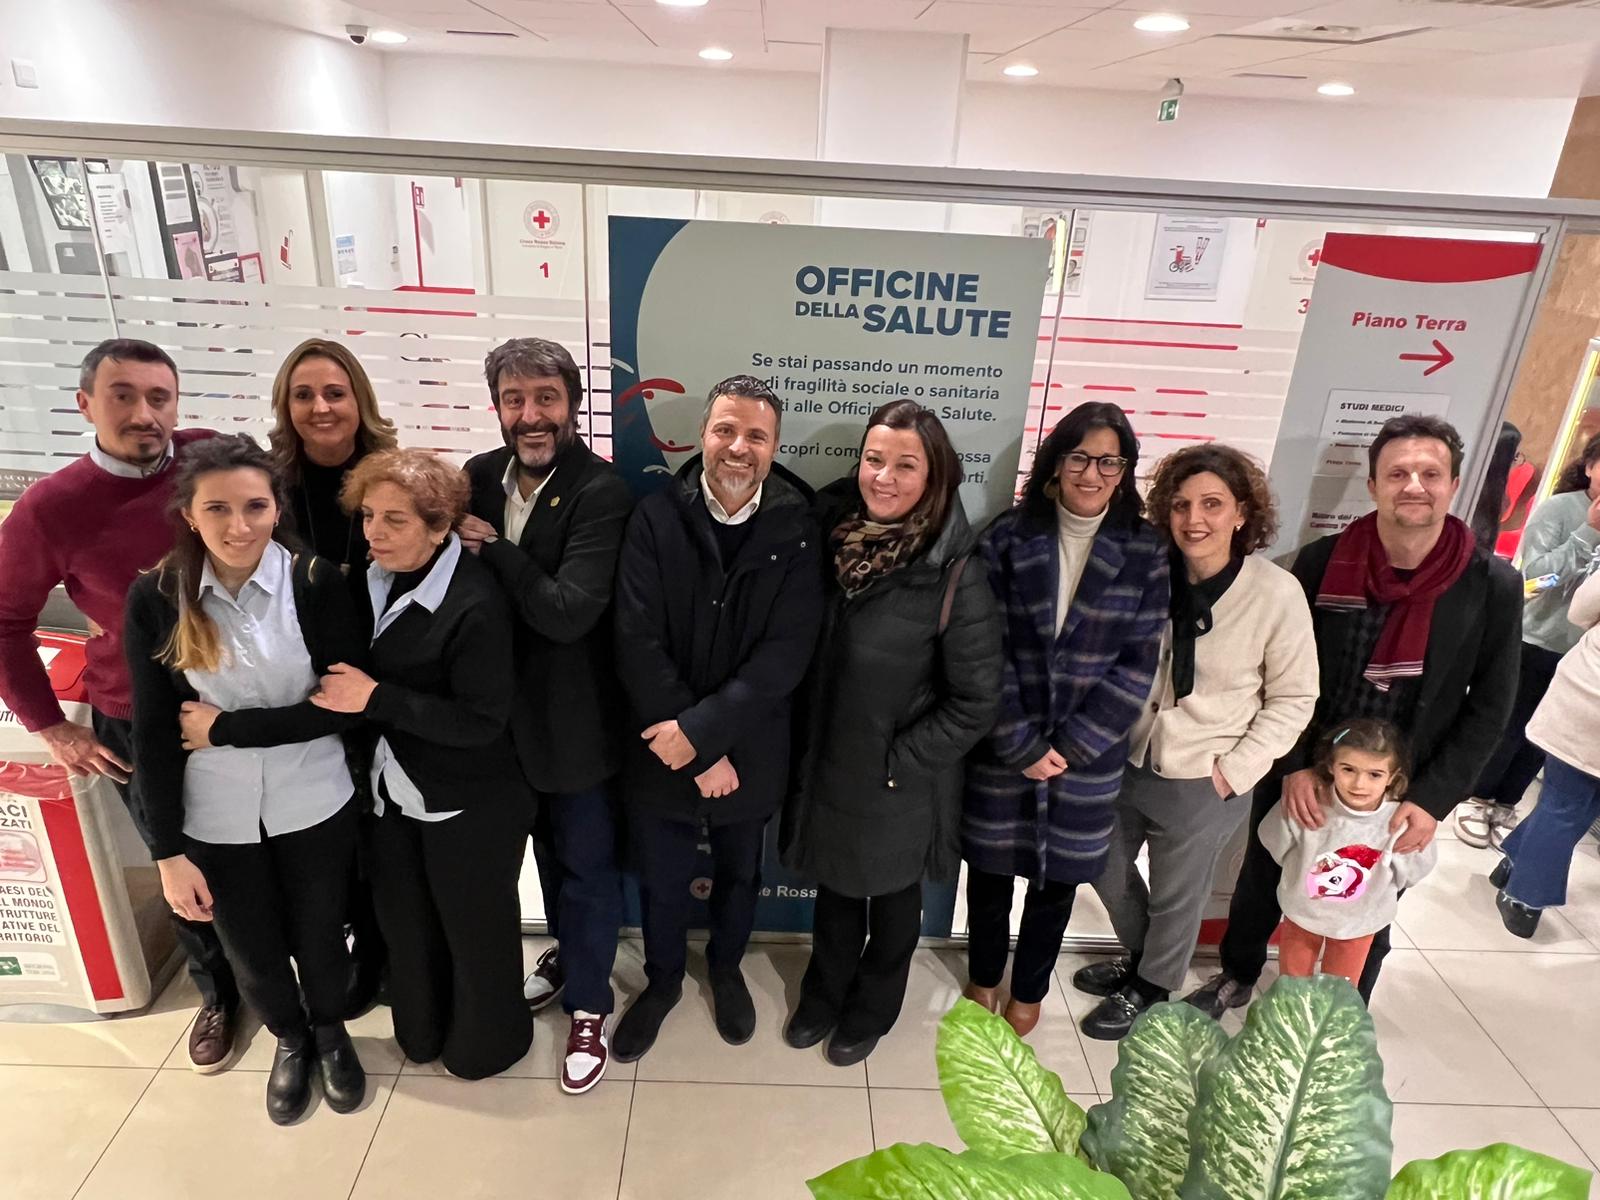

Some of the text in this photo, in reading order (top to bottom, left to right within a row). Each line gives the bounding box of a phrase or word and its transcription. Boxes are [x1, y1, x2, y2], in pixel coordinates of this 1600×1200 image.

[539, 262, 549, 278] 1
[795, 265, 980, 302] OFFICINE
[795, 301, 1012, 339] DELLA SALUTE
[1351, 311, 1468, 332] Piano Terra
[752, 353, 1003, 378] Se stai passando un momento
[765, 376, 1000, 400] di fragilità sociale o sanitaria
[793, 399, 823, 413] alle
[828, 400, 881, 416] Officin
[941, 405, 997, 421] Salute.
[1340, 402, 1405, 413] STUDI MEDICI
[777, 442, 860, 459] copri com
[958, 452, 992, 464] ossa
[777, 885, 818, 898] Ross
[12, 898, 54, 910] MONDO
[39, 922, 61, 933] DEL
